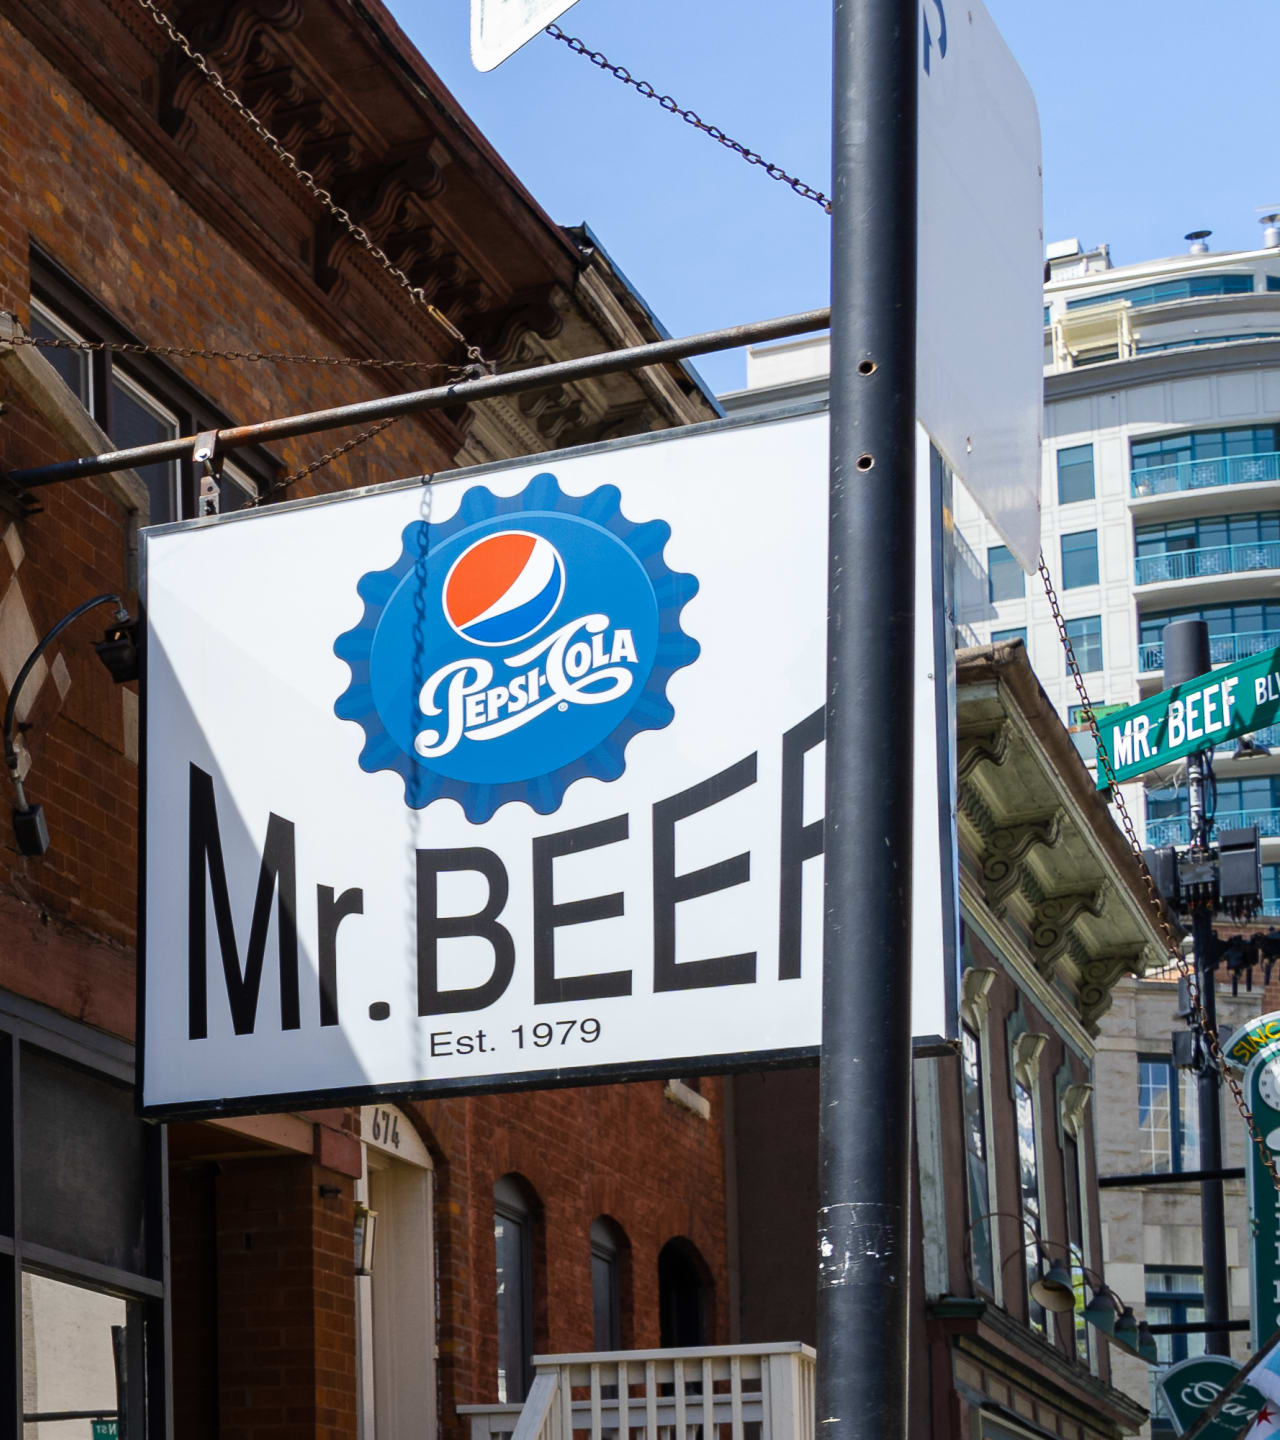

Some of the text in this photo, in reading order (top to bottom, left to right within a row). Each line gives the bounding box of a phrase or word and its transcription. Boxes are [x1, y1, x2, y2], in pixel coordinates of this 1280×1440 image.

[1113, 714, 1158, 770] MR.
[1168, 676, 1239, 748] BEEF
[188, 760, 391, 1041] Mr.
[430, 1017, 602, 1058] Est. 1979
[373, 1107, 399, 1149] 674
